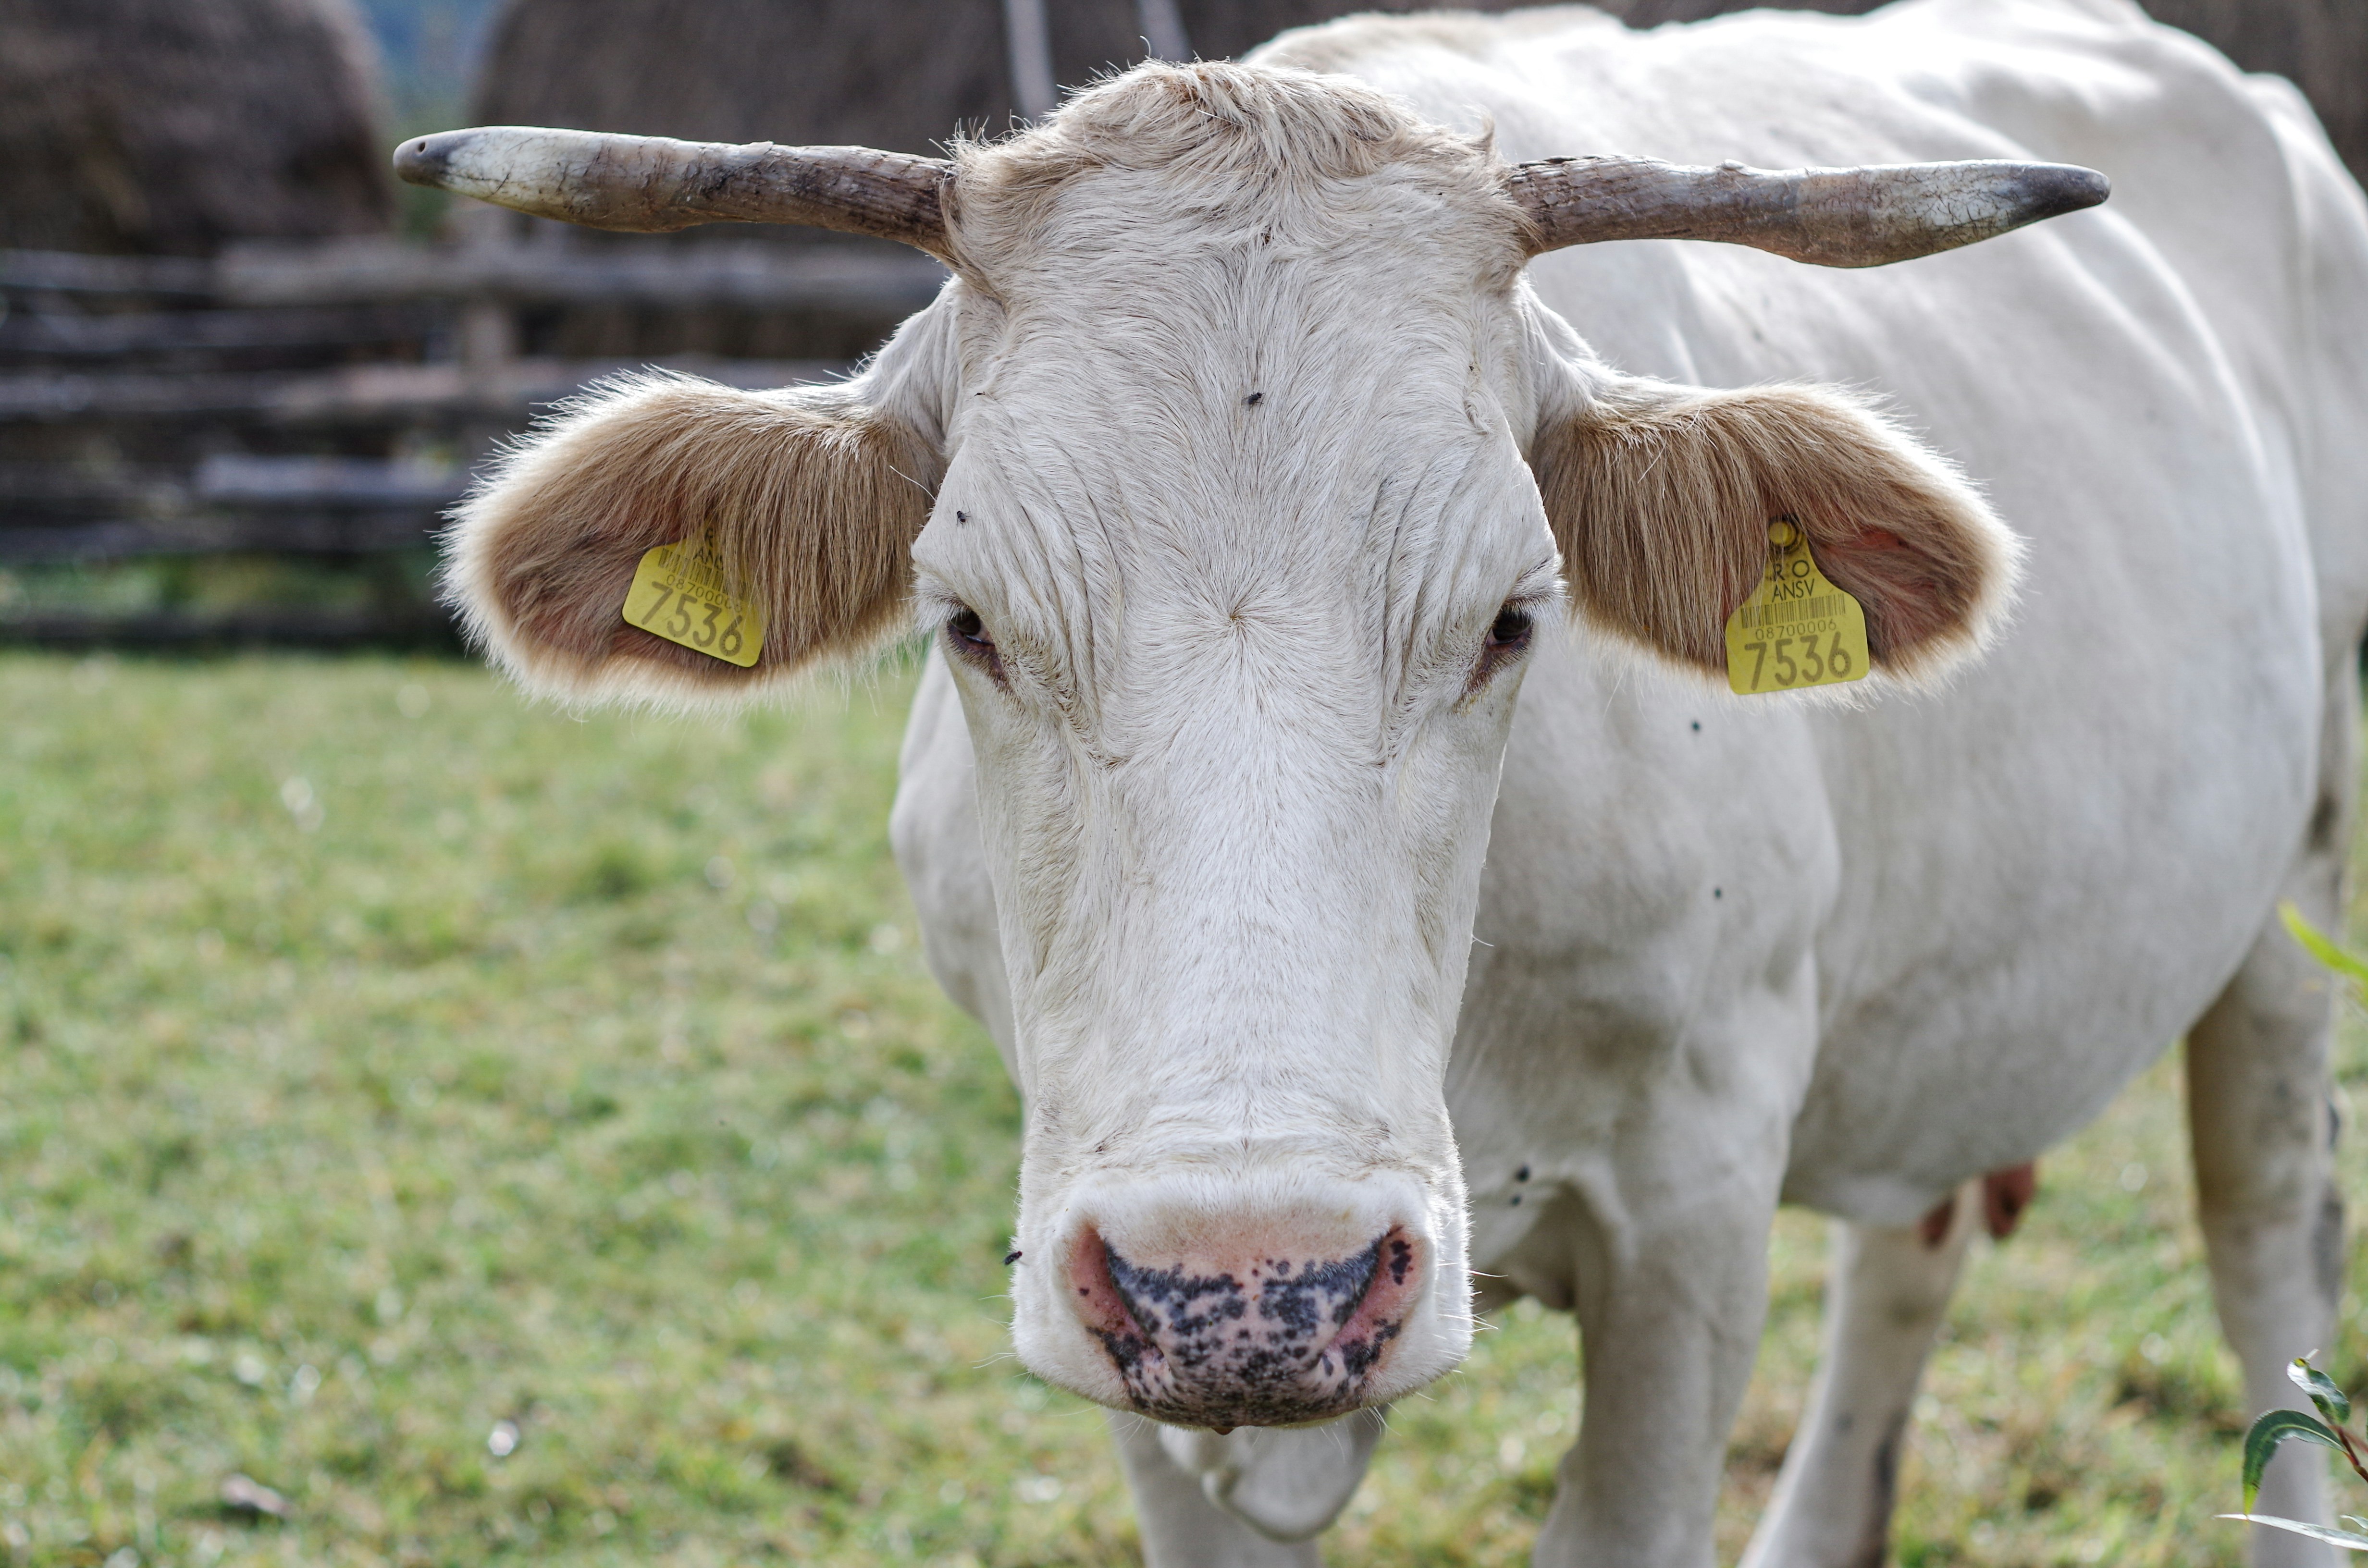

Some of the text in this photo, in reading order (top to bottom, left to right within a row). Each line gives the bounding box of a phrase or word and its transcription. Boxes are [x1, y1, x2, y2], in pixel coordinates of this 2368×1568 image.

[1772, 578, 1814, 603] ANSV
[641, 581, 742, 657] 7536
[1755, 619, 1837, 640] 08700006
[1744, 631, 1851, 691] 7536
